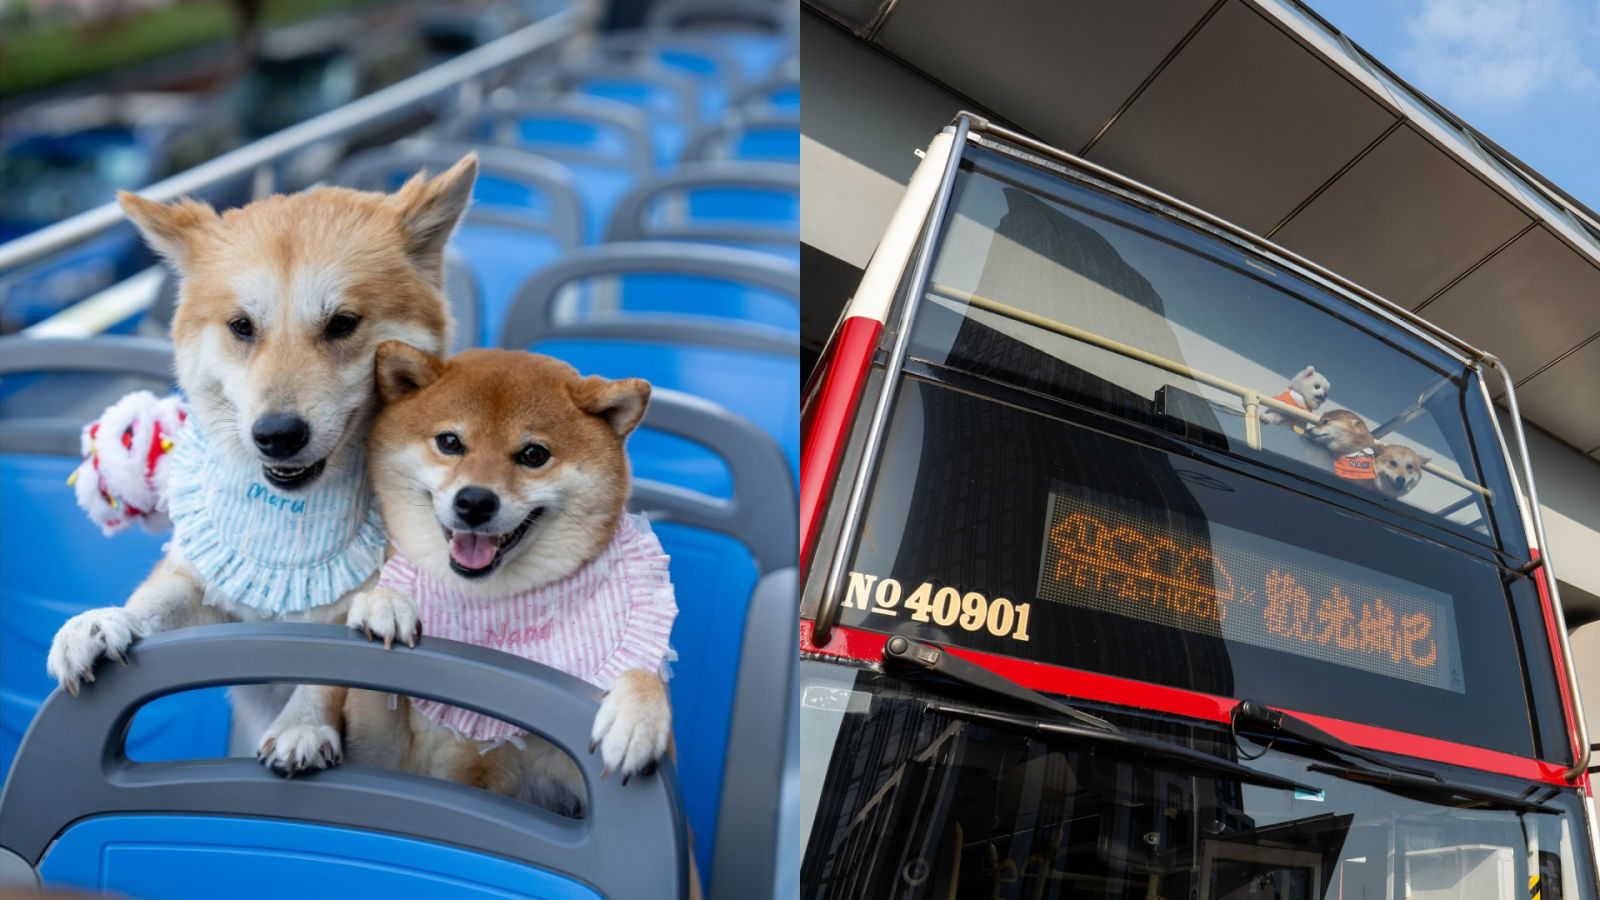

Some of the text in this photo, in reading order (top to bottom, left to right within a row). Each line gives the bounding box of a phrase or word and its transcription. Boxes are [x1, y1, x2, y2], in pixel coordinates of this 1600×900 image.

[904, 582, 1031, 642] 40901
[1055, 559, 1228, 622] PET-A-HOOD
[1263, 569, 1438, 668] 觀光城巴
